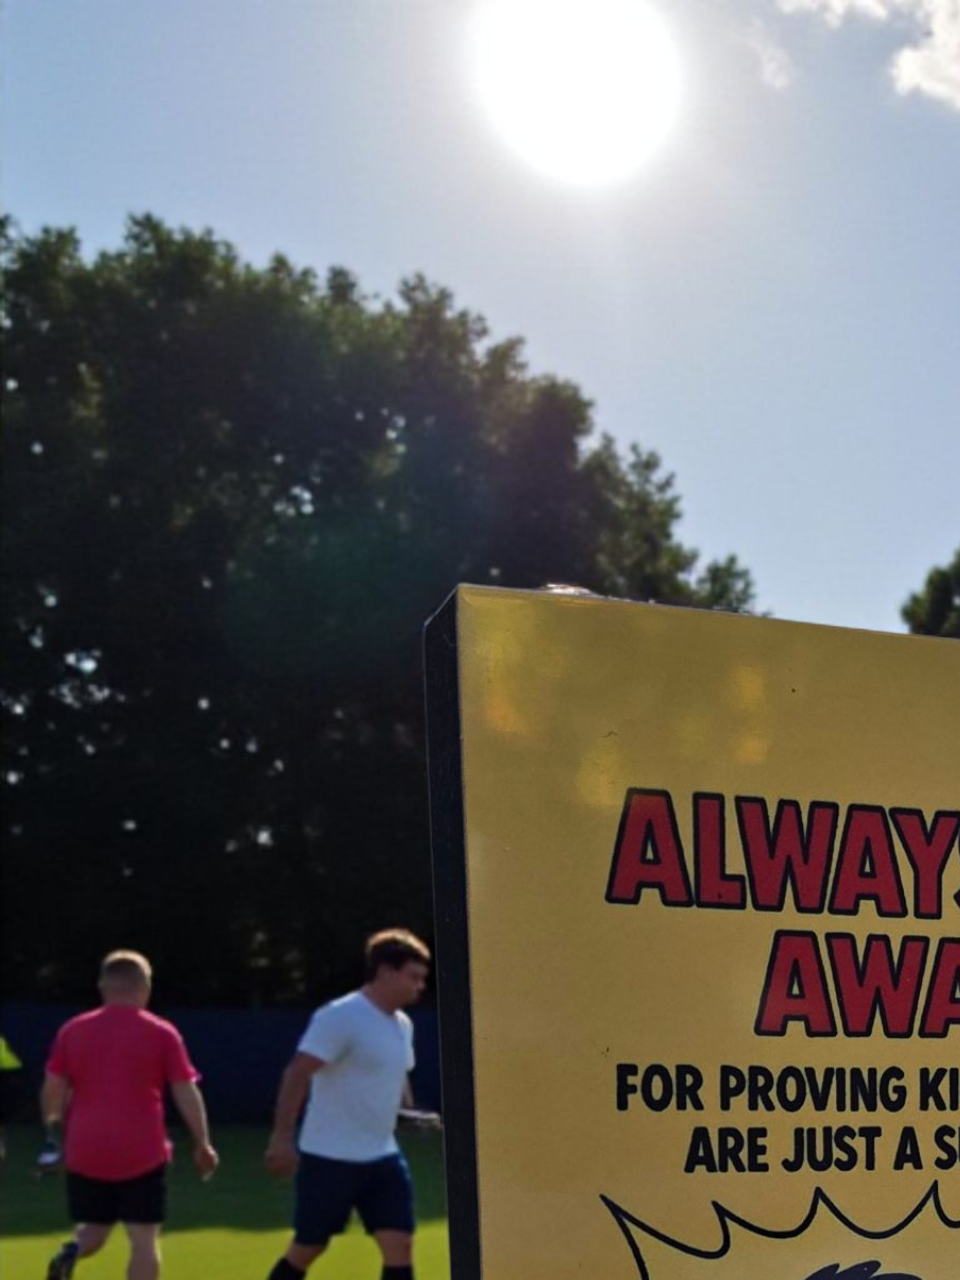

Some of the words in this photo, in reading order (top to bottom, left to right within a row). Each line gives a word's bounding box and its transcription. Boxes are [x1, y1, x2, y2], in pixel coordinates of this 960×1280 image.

[615, 1063, 704, 1113] FOR
[719, 1065, 907, 1113] PROVING
[684, 1127, 769, 1173] ARE
[781, 1126, 882, 1172] JUST
[893, 1125, 923, 1170] A
